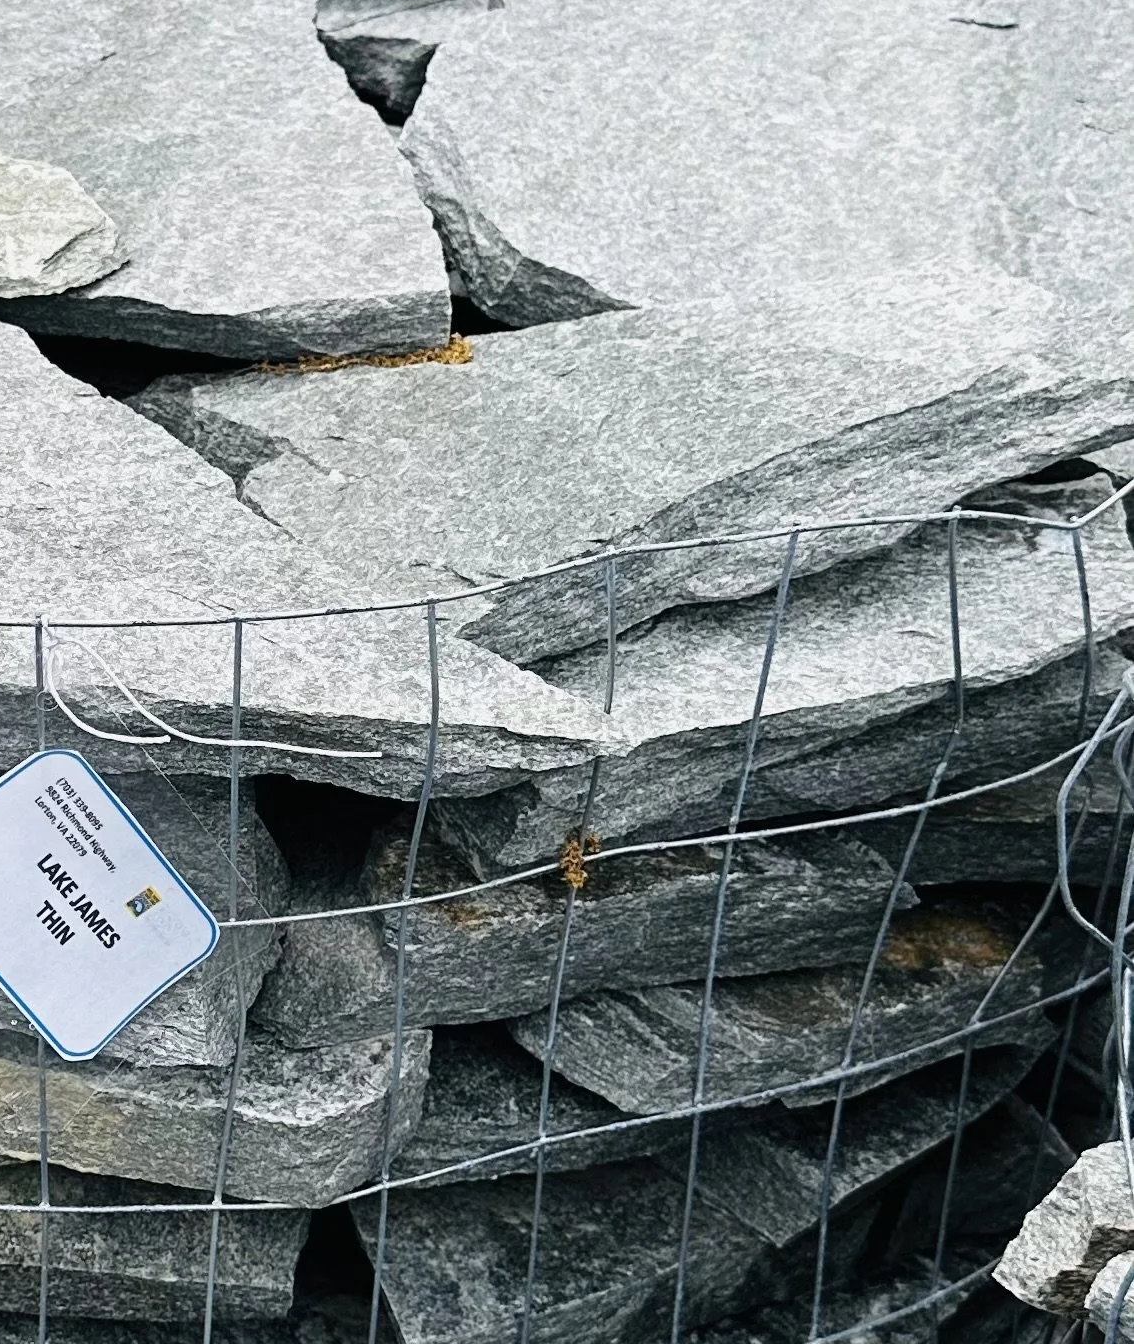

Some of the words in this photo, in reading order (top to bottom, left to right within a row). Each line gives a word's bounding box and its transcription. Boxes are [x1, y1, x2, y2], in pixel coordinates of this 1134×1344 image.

[56, 777, 77, 799] (703)
[35, 796, 56, 825] Lorton,
[57, 821, 68, 836] VA
[65, 834, 88, 856] 22079
[60, 804, 93, 841] Richmond
[89, 839, 116, 873] Highway,
[36, 900, 75, 945] THIN
[37, 853, 78, 898] LAKE
[69, 894, 120, 948] JAMES
